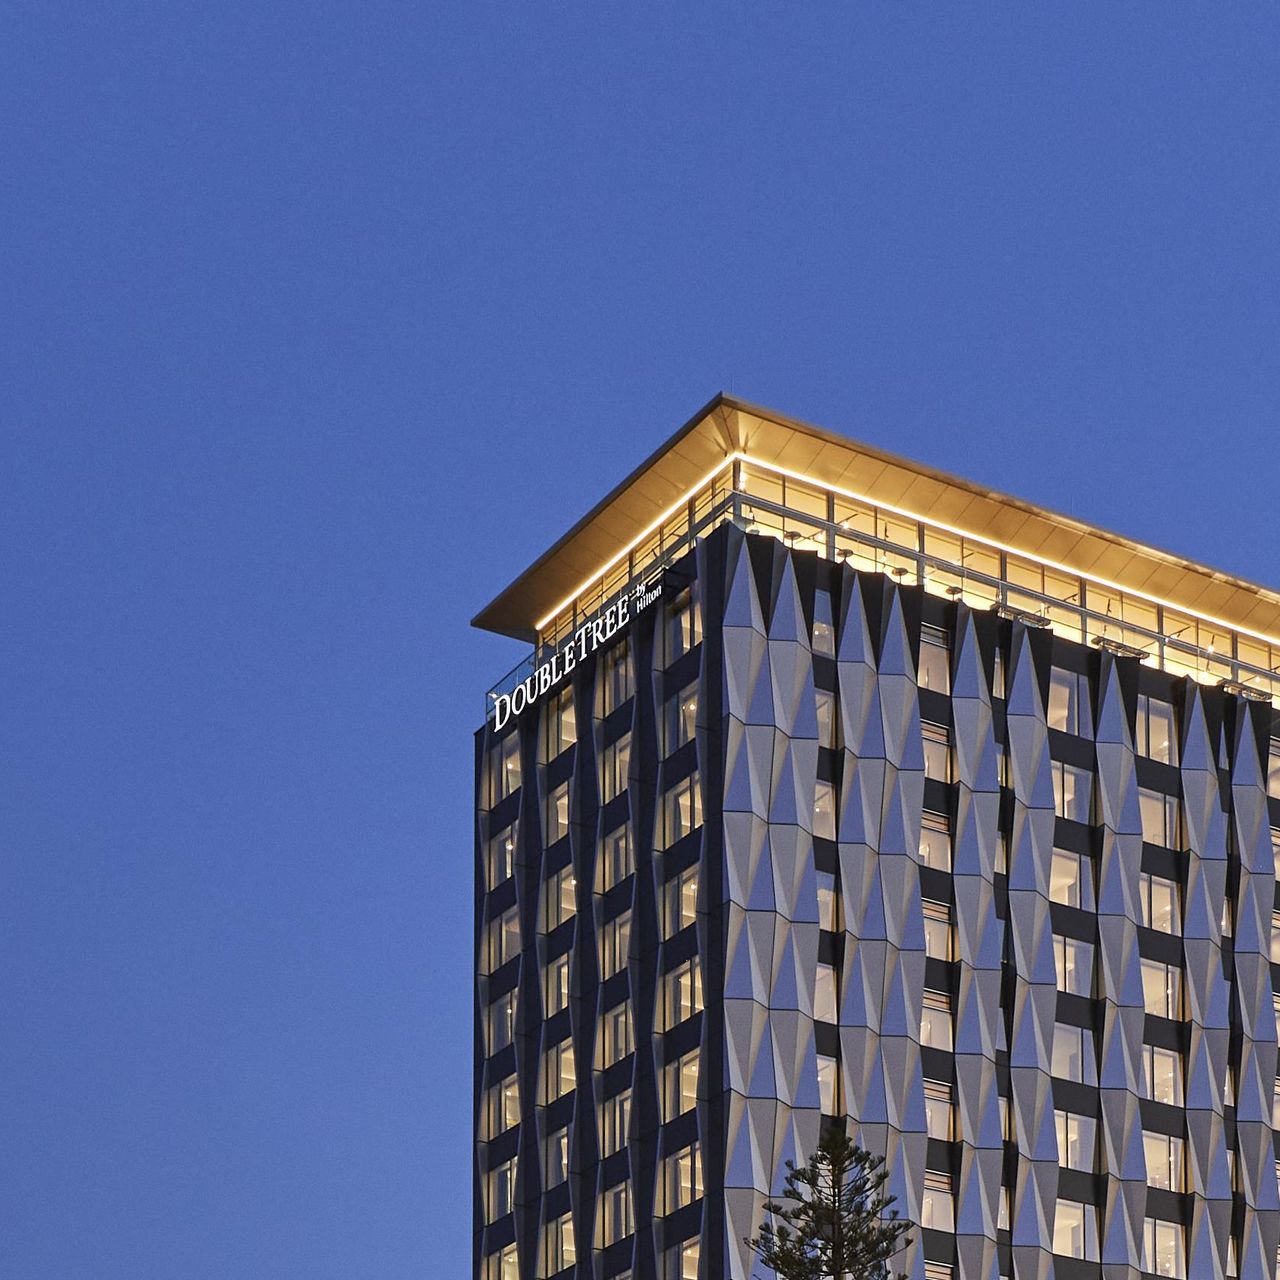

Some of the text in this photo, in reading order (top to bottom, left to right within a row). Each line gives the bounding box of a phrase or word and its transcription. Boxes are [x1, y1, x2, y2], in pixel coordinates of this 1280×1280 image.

[636, 583, 646, 597] by
[636, 585, 662, 614] Hilton
[494, 594, 630, 733] DOUBLETREE
